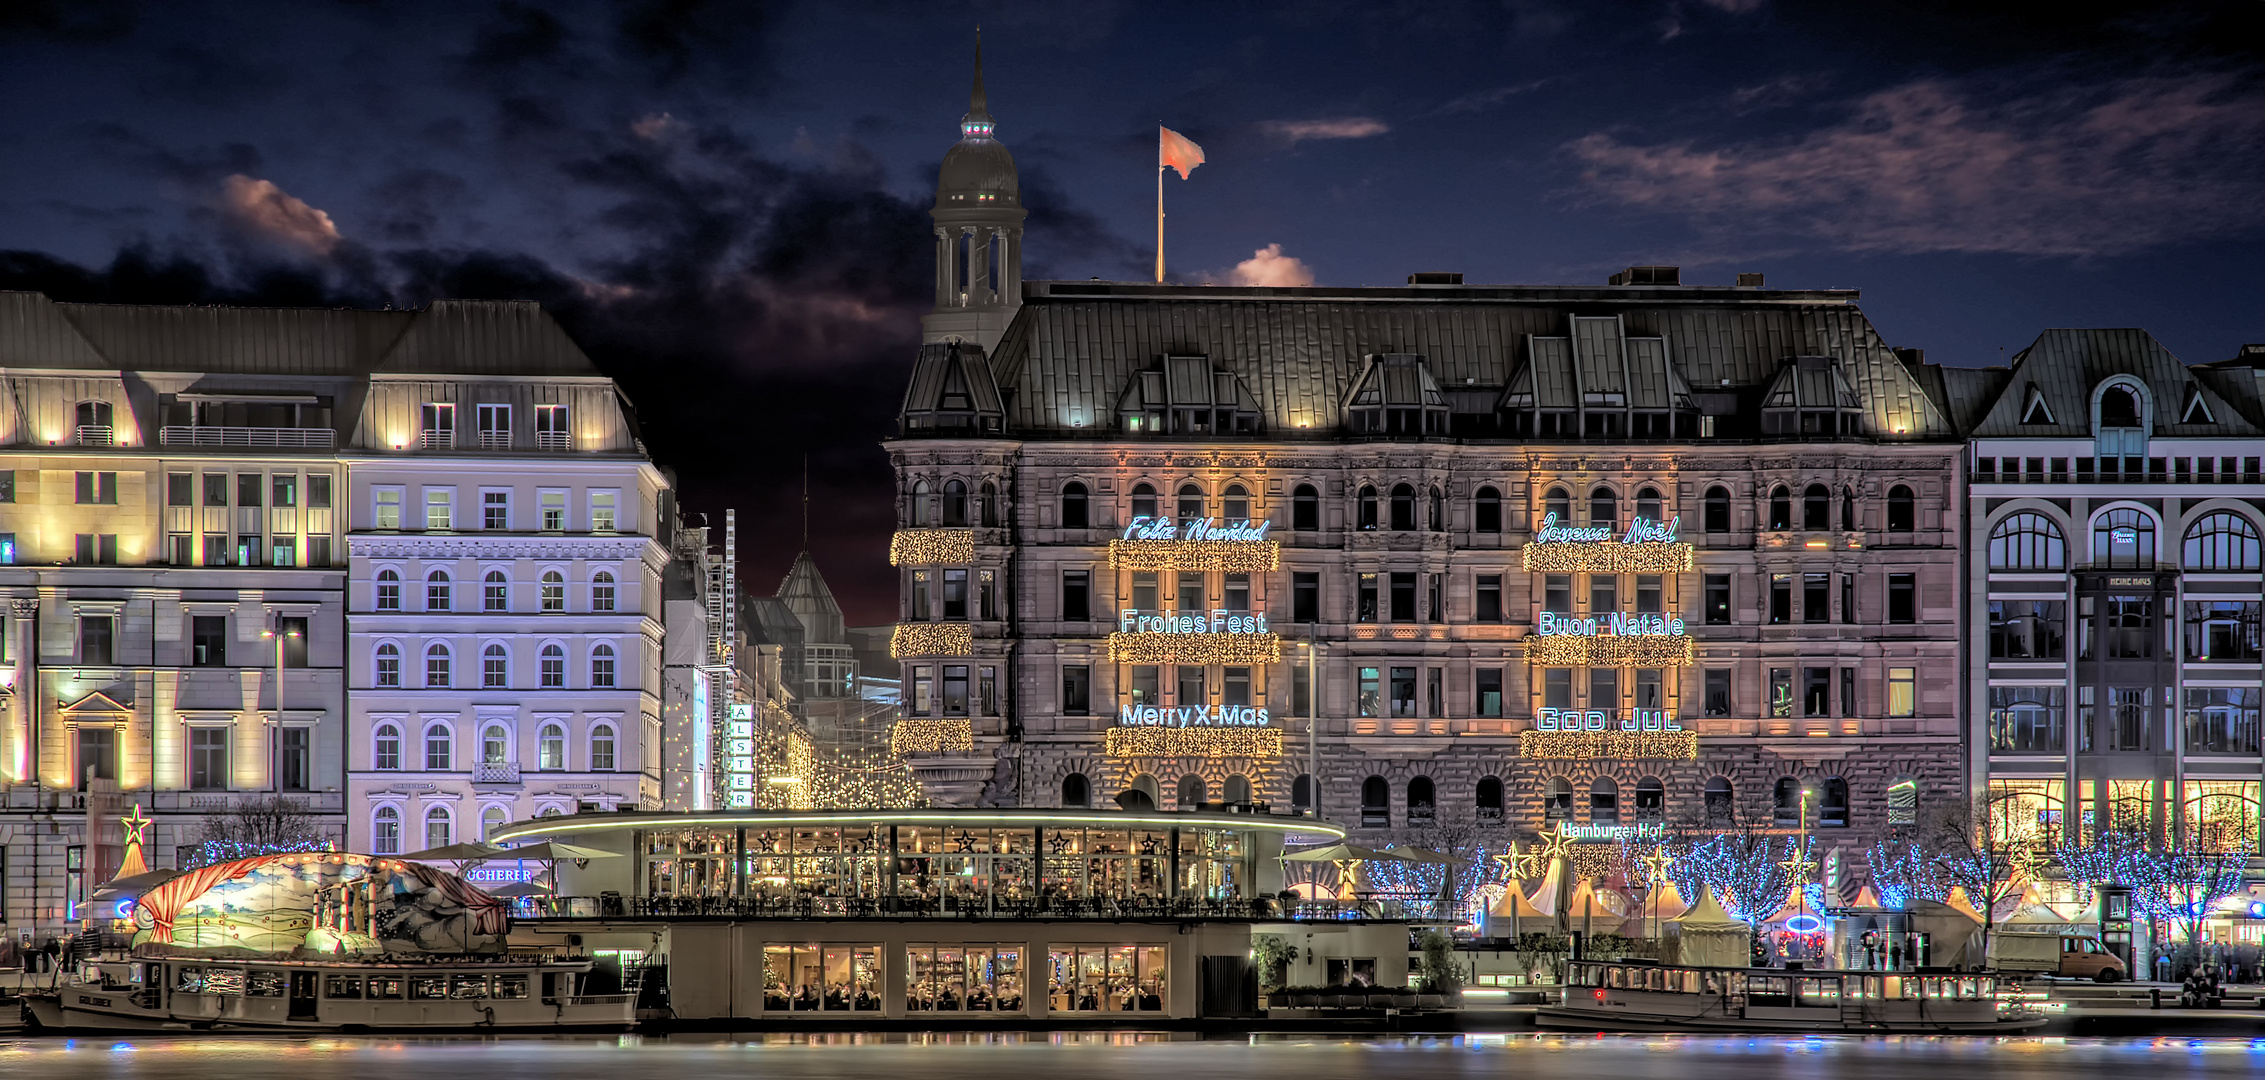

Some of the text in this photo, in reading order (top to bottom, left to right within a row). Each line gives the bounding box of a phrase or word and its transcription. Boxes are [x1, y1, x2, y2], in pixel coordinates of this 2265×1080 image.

[1123, 515, 1270, 542] Feliz Navidad
[1537, 511, 1679, 543] Joyeux Noël
[2110, 577, 2151, 585] HEINE HAUS
[1121, 608, 1268, 634] Frohes Fest
[1539, 611, 1684, 636] Buon Natale
[1122, 704, 1268, 729] Merry X-Mas
[736, 708, 746, 804] ALSTER
[1561, 822, 1664, 840] Hamburger Hof
[465, 869, 532, 881] UCHERER
